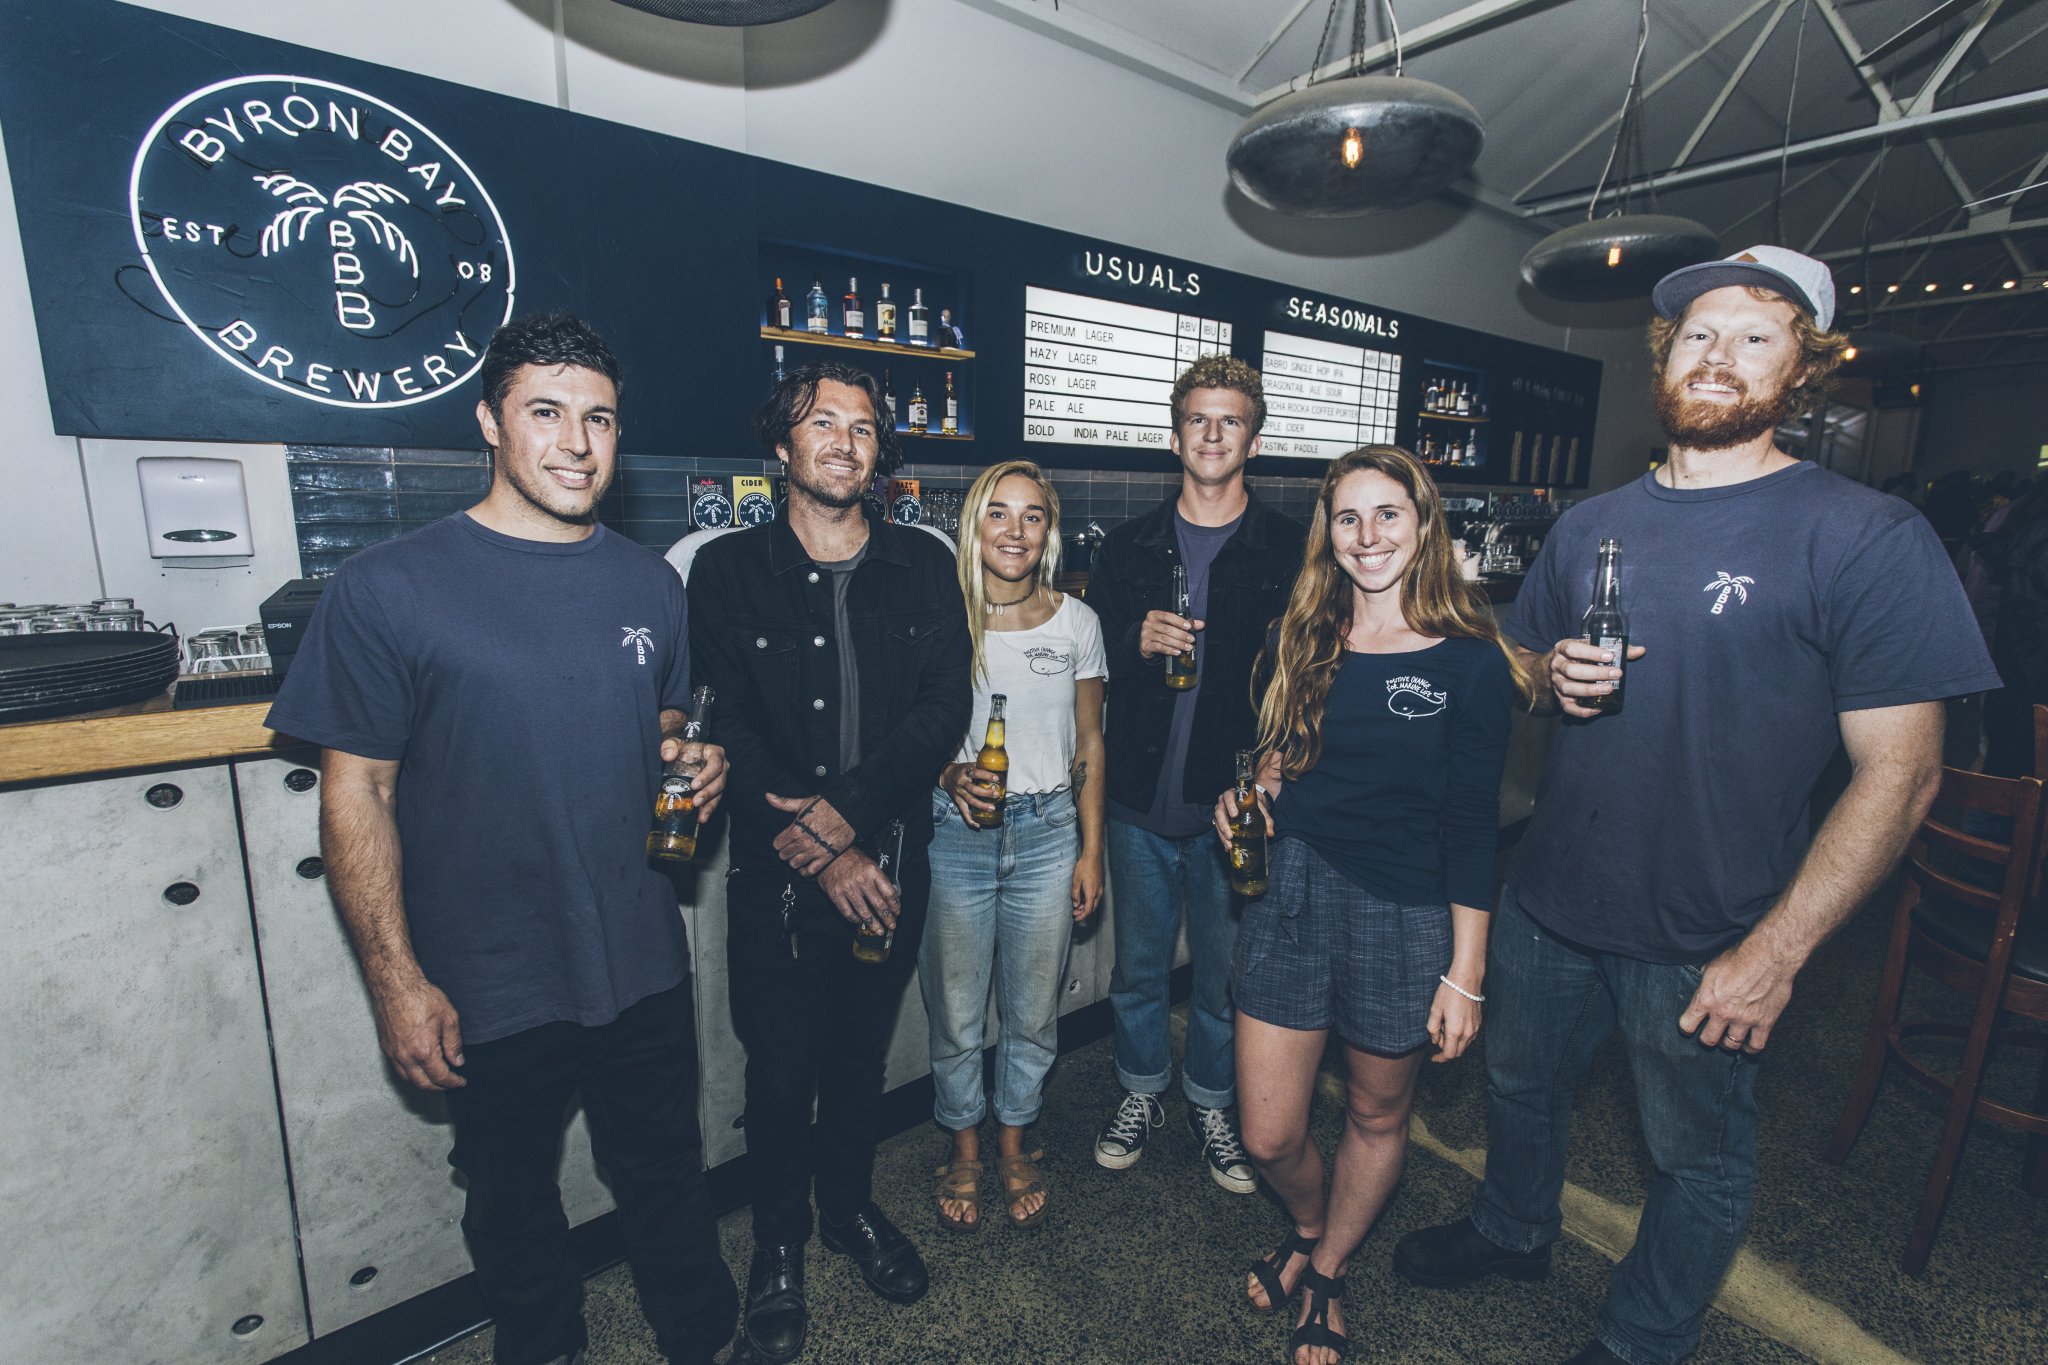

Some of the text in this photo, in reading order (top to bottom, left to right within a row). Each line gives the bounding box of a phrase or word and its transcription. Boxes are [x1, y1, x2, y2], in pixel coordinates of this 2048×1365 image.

[180, 95, 466, 207] BYRON BAY
[163, 217, 225, 246] EST
[457, 261, 492, 283] 08
[1086, 251, 1200, 296] USUALS
[1287, 297, 1399, 338] SEASONALS
[1030, 320, 1114, 343] PREMIUM LAGER
[1180, 321, 1197, 332] ABV
[1203, 326, 1216, 336] IBU
[218, 319, 480, 402] BREWERY
[1030, 347, 1098, 365] HAZY LAGER
[1264, 358, 1344, 378] SABRO SINGLE HOP IPA
[1029, 373, 1096, 390] ROSY LAGER
[1262, 378, 1343, 398] DRAGONTAIL ALE SOUR
[1029, 398, 1084, 414] PALE ALE
[1312, 405, 1335, 415] COFFEE
[1028, 424, 1164, 444] BOLD INDIA PALE LAGER
[1286, 422, 1305, 432] CIDER
[1294, 442, 1318, 454] PADDLE
[698, 496, 726, 506] BYRON BAY
[743, 496, 770, 506] BYRON BAY
[1386, 676, 1432, 690] POSITIVE CHANGE
[1386, 682, 1432, 698] FOR MARINE LIFE
